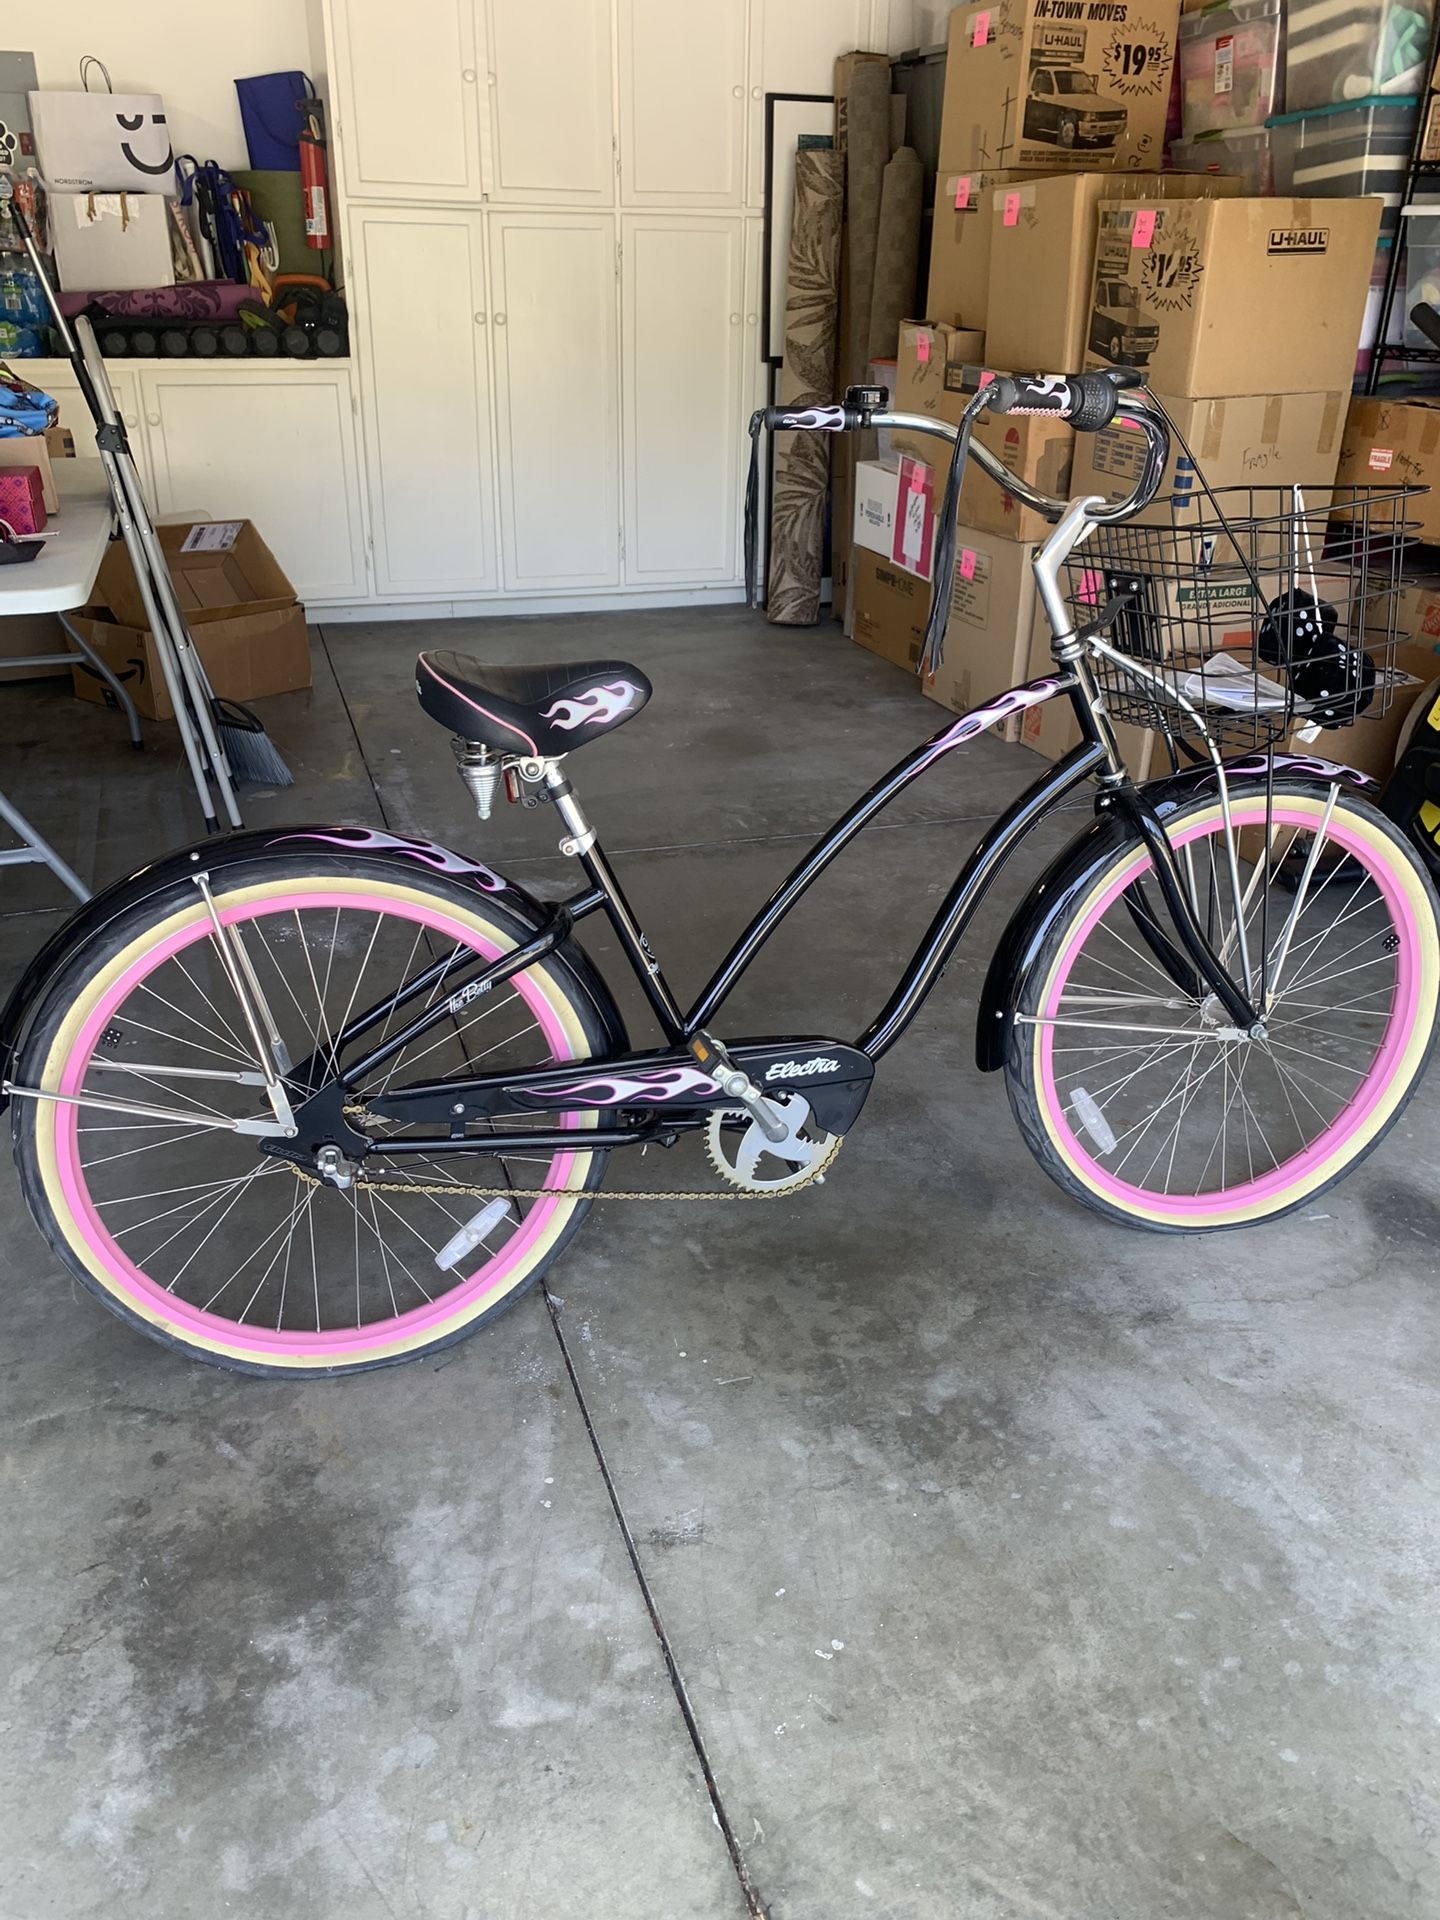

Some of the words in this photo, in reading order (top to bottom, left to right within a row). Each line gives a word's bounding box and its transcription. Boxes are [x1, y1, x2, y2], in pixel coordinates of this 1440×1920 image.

[1034, 0, 1082, 19] IN-TOWN
[1087, 3, 1127, 22] MOVES
[54, 178, 93, 186] NORDSTROM
[1271, 231, 1326, 246] U-HAUL
[1219, 587, 1247, 597] LARGE
[1181, 602, 1211, 610] GRAND
[1212, 600, 1251, 608] ADICIONAL
[765, 1057, 841, 1081] Electra
